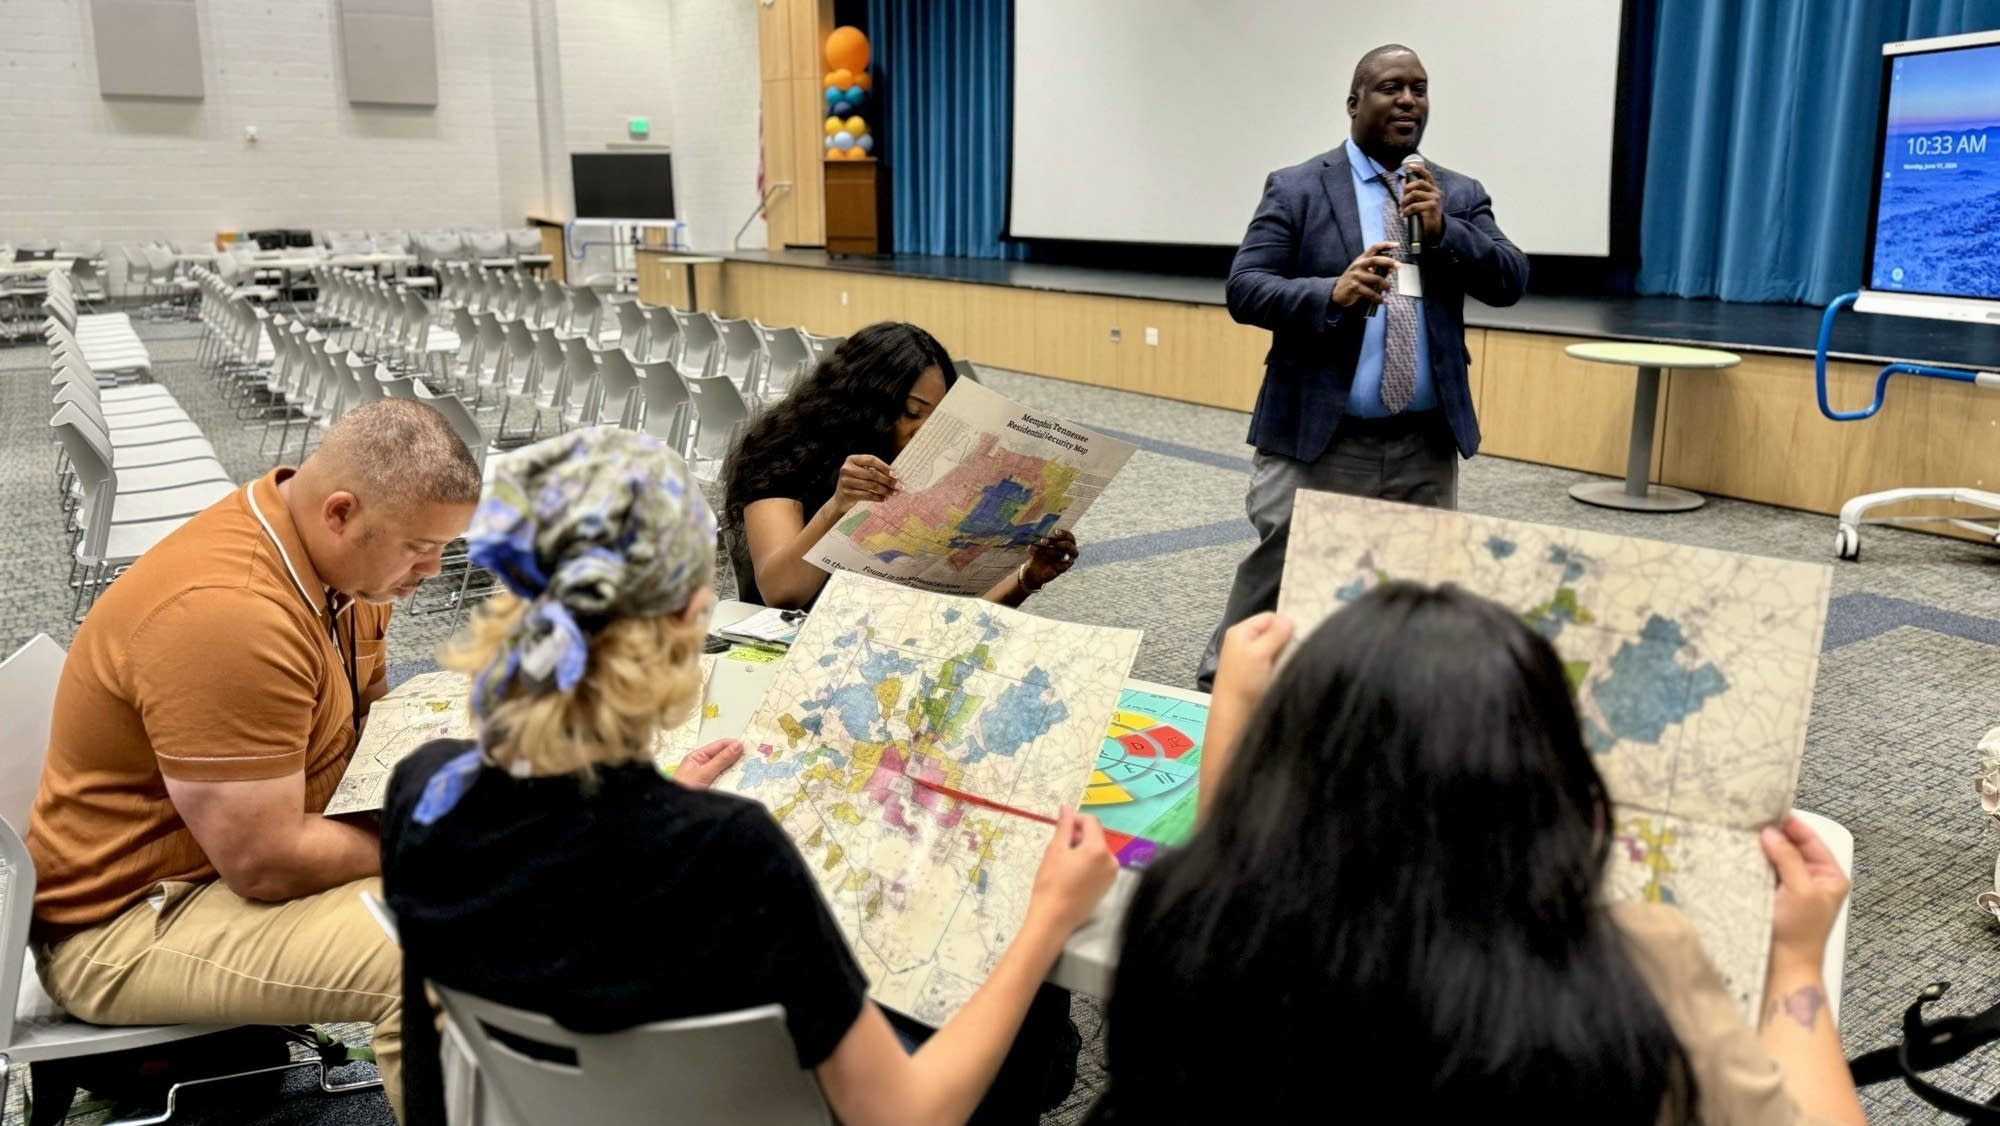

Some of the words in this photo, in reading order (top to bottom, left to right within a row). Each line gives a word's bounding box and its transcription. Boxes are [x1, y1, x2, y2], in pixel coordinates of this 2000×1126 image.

[1907, 135, 1953, 155] 10:33
[1956, 134, 1987, 154] AM
[1006, 420, 1046, 440] Residential
[1072, 444, 1089, 456] Map
[1053, 422, 1089, 443] Tennessee
[821, 556, 832, 565] in
[862, 565, 888, 578] Found
